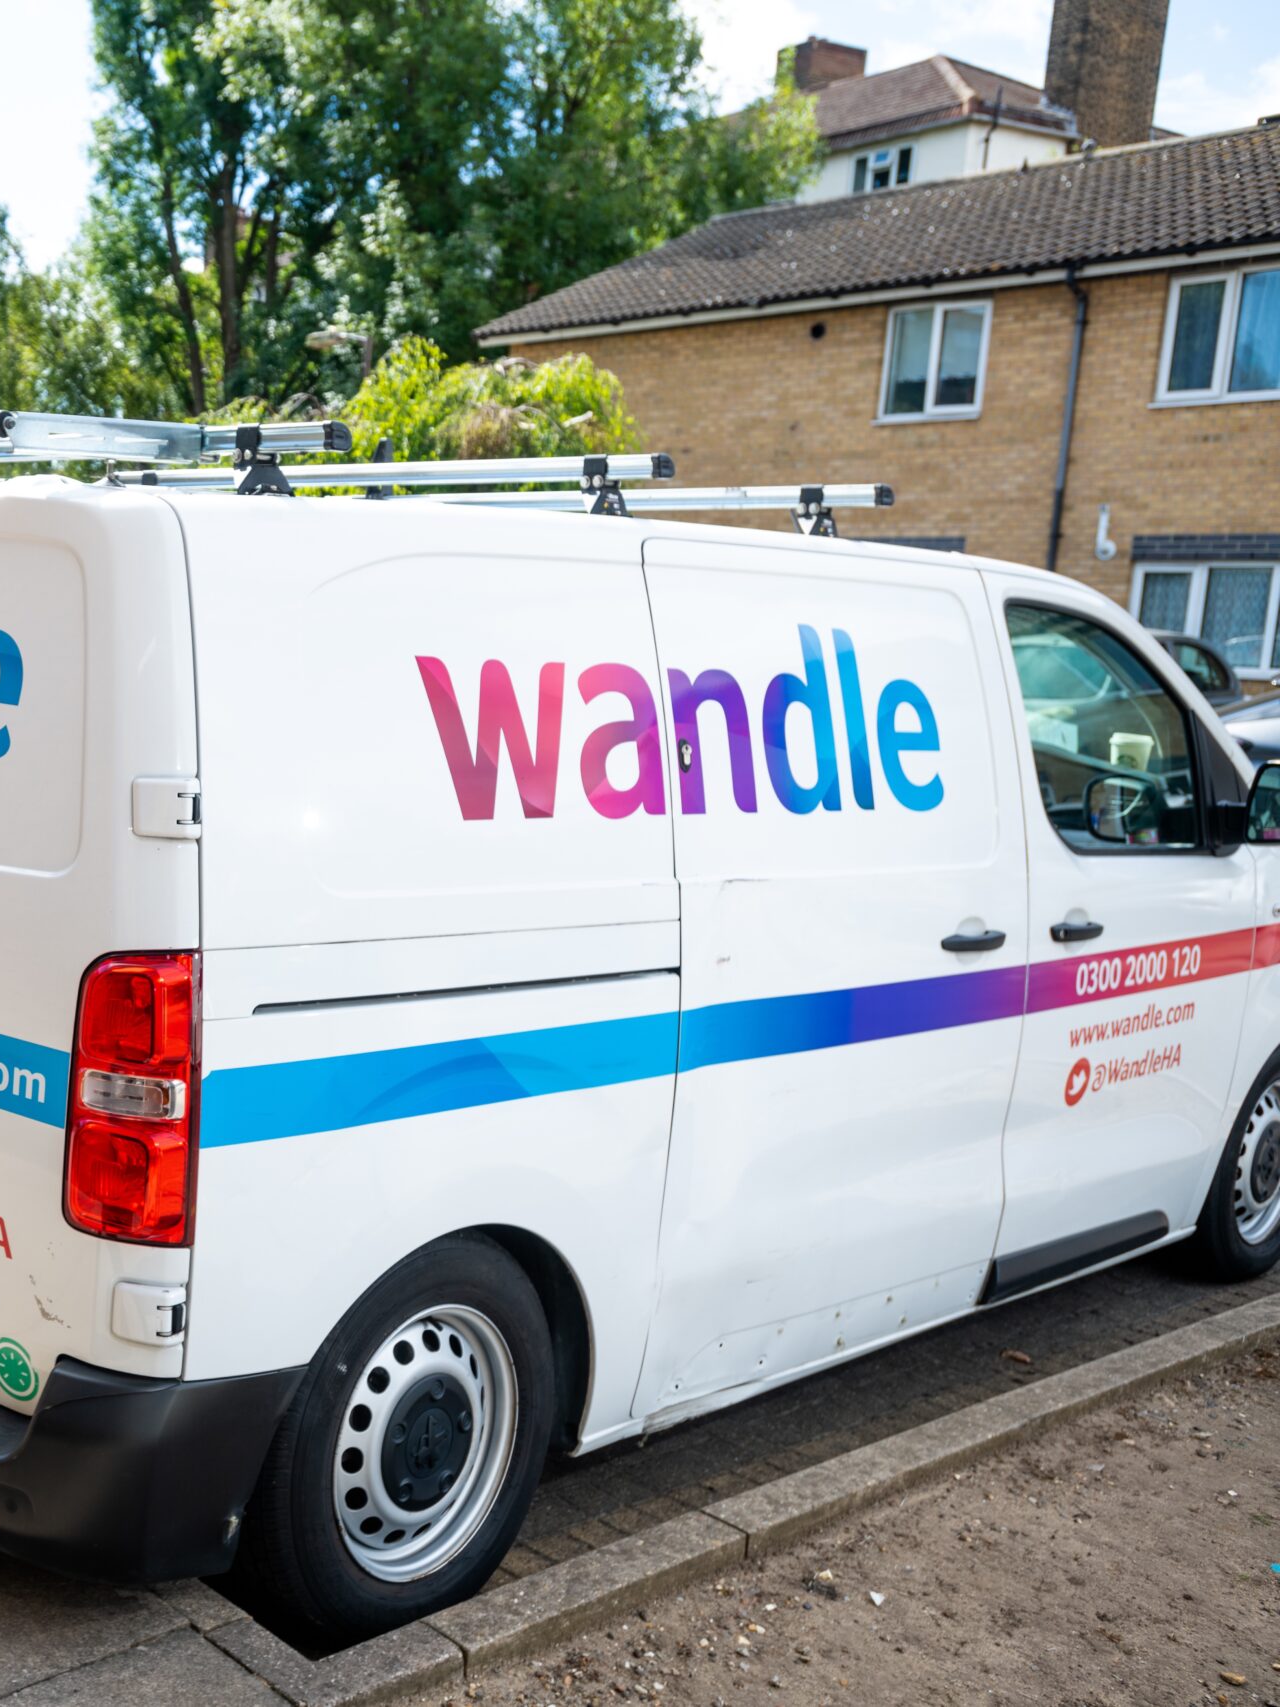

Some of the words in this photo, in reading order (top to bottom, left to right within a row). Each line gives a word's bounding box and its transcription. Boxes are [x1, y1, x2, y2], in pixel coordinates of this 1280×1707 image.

[414, 624, 944, 820] wandle
[1076, 957, 1122, 996] 0300
[1124, 950, 1167, 987] 2000
[1172, 944, 1201, 977] 120
[1070, 1001, 1195, 1048] www.wandle.com
[1091, 1043, 1182, 1092] @WandleHA
